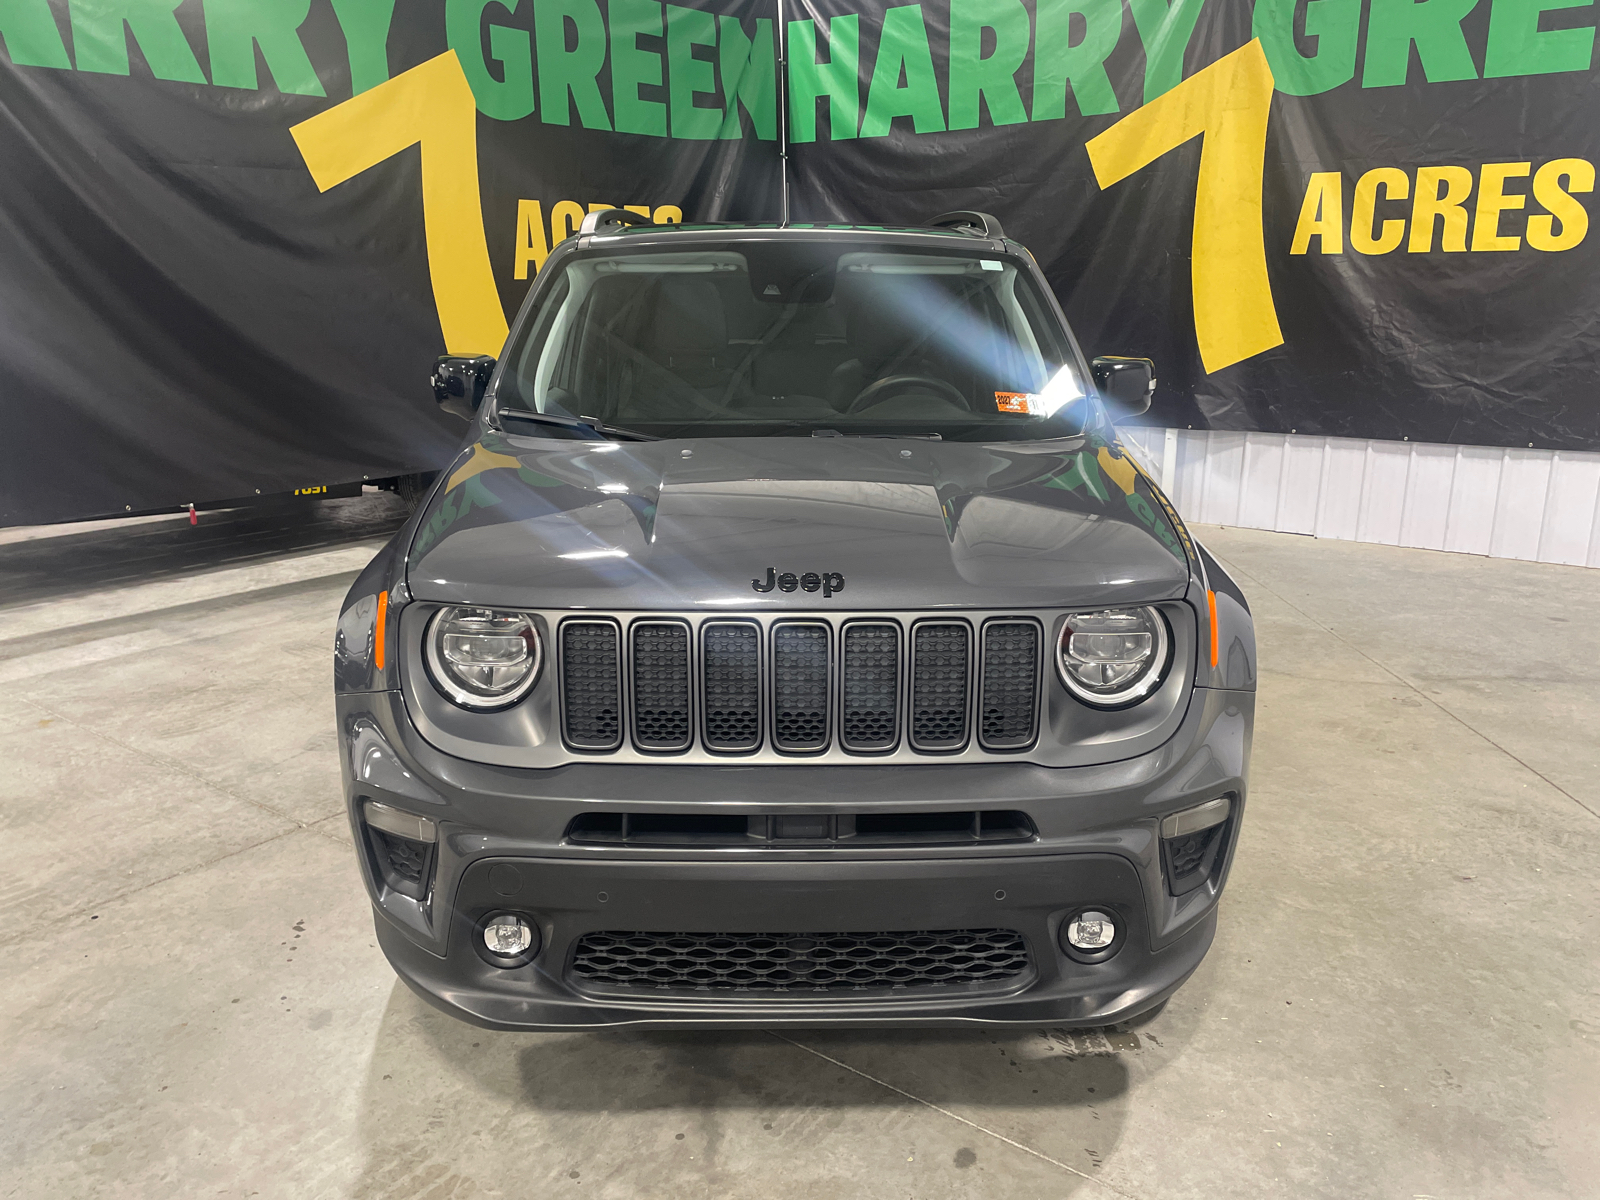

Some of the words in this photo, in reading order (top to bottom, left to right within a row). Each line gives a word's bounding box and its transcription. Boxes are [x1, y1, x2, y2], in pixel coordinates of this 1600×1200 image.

[445, 0, 778, 141] GREEN
[786, 0, 1205, 144] HARRY
[289, 48, 510, 360] 7
[1085, 37, 1284, 375] 7
[1290, 157, 1596, 256] ACRES
[751, 566, 845, 598] Jeep
